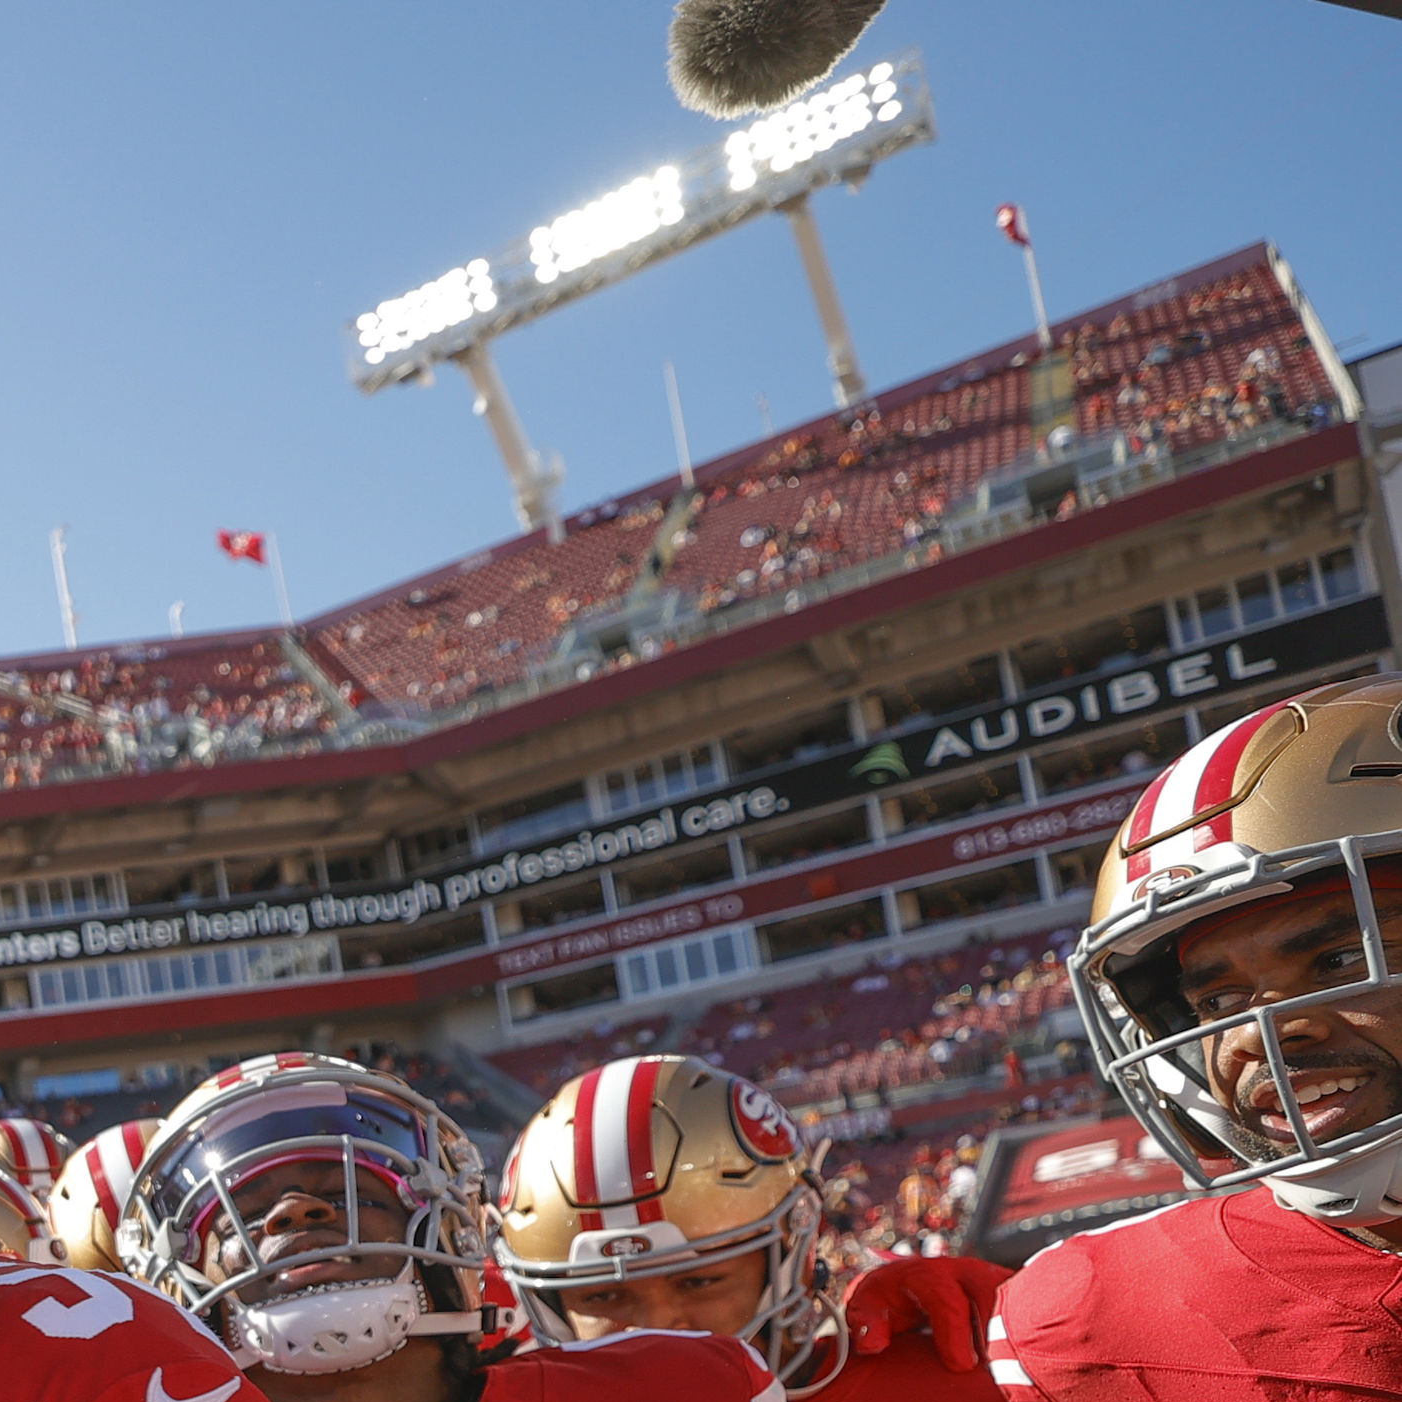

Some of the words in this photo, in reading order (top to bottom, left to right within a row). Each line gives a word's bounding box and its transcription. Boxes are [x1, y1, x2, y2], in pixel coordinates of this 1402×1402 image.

[924, 643, 1277, 768] AUDIBEL
[81, 915, 186, 956] Better
[187, 902, 310, 940] hearing
[311, 880, 440, 925] through
[443, 807, 677, 912] professional
[680, 785, 790, 836] care.
